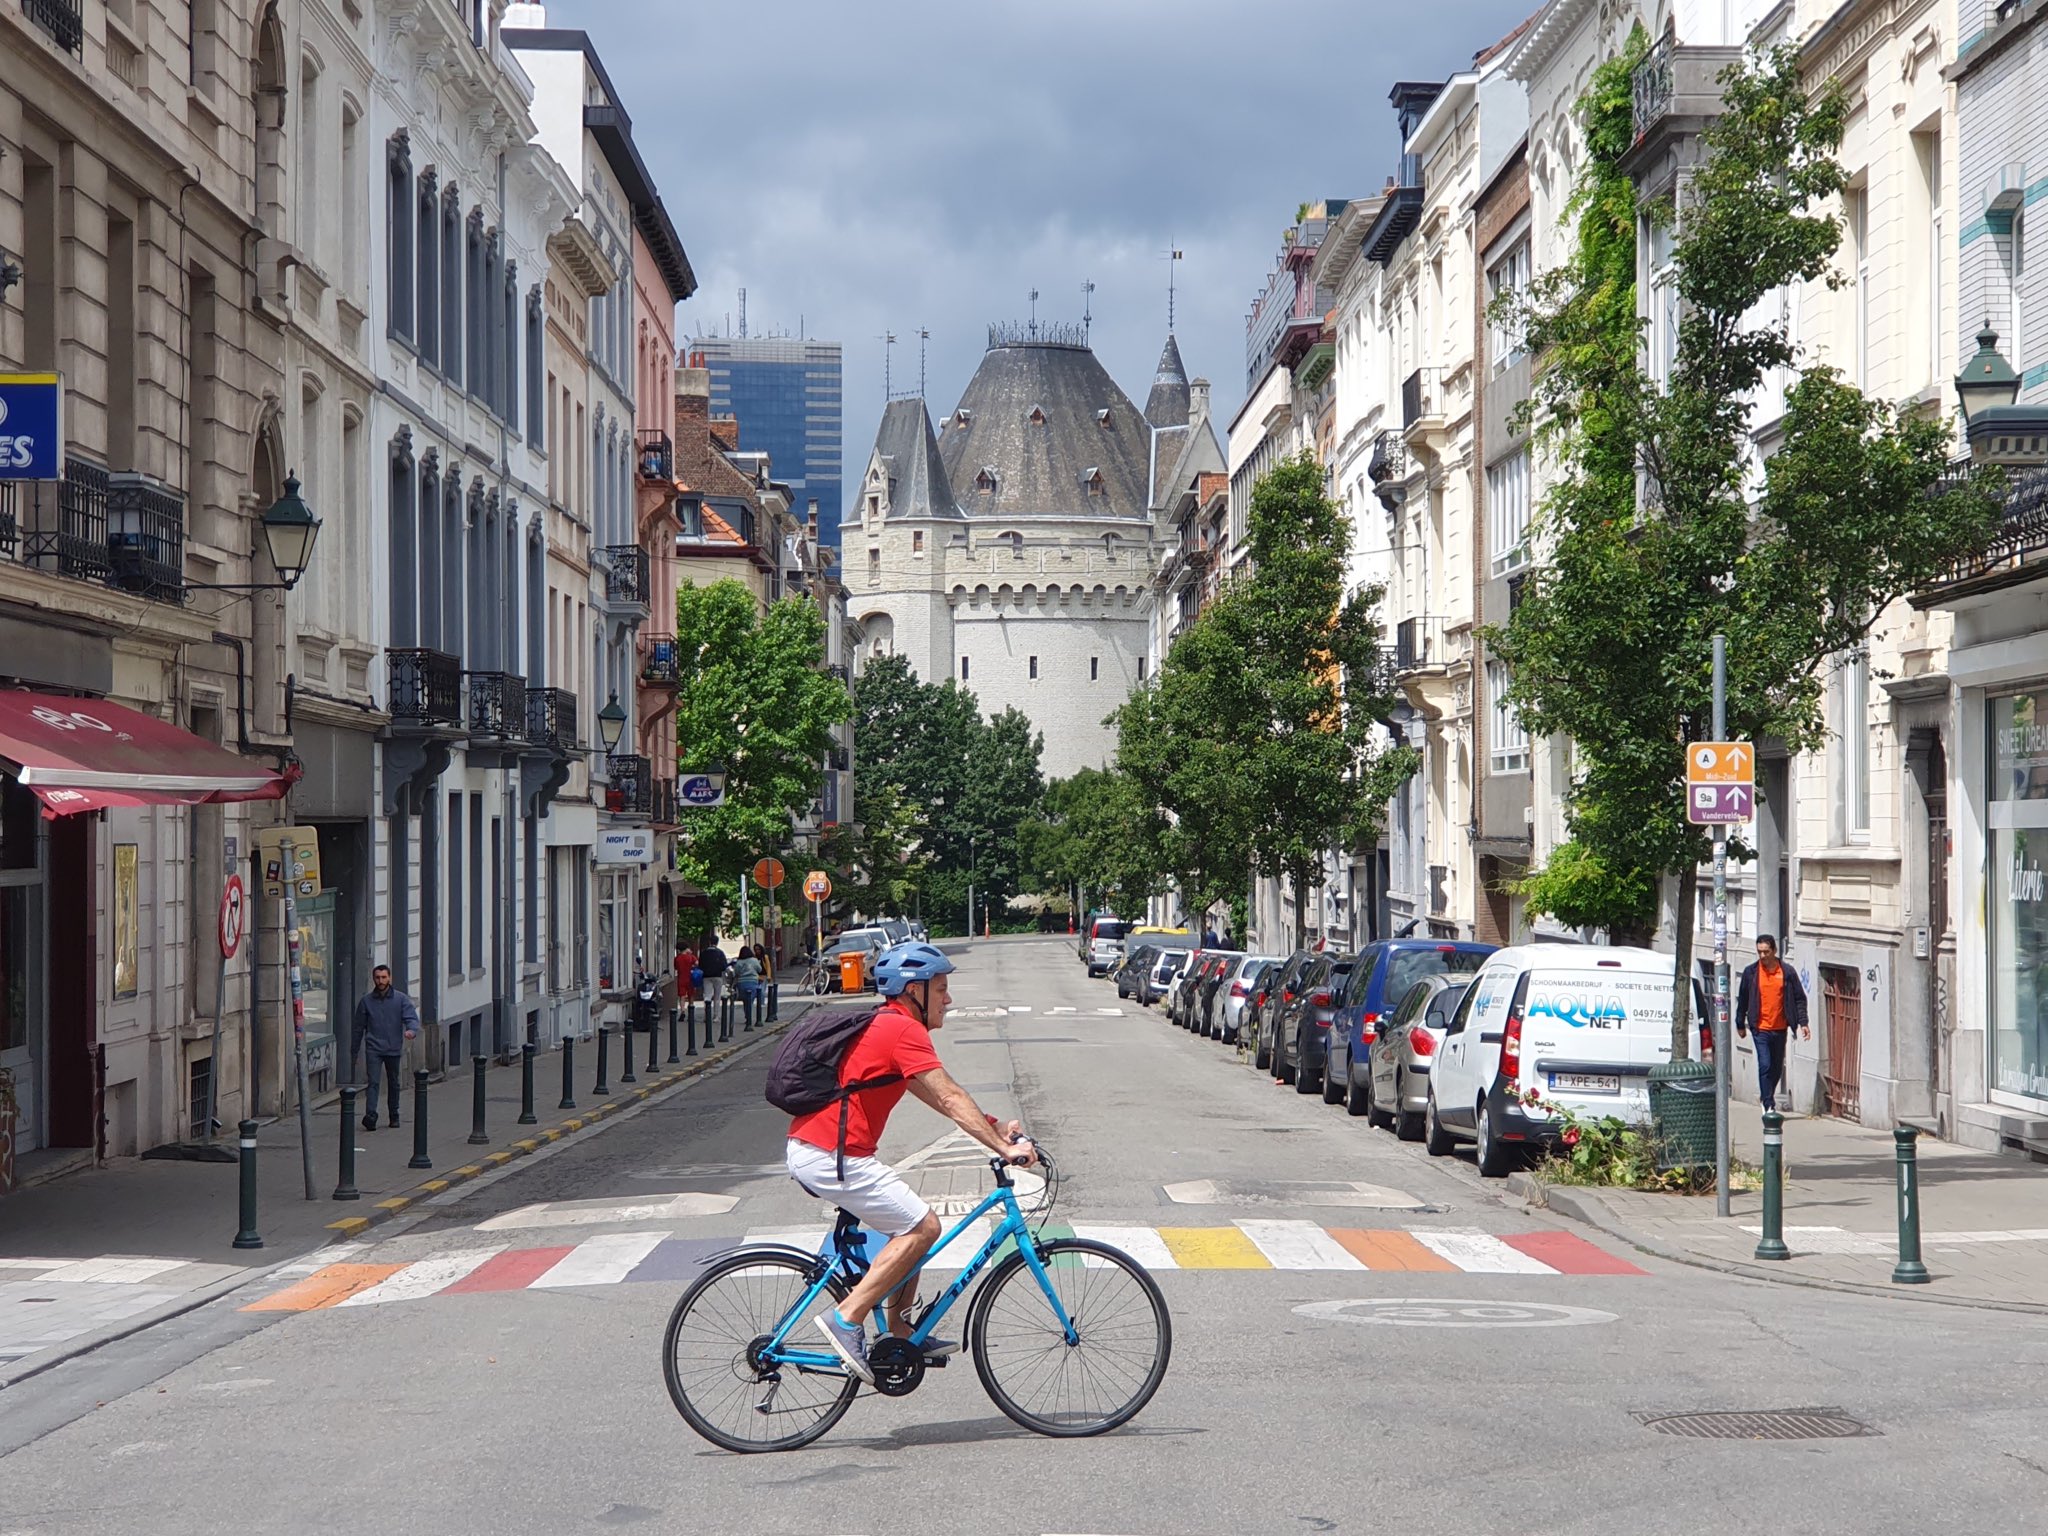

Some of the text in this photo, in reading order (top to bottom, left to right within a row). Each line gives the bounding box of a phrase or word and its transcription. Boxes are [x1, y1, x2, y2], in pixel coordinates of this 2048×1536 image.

[1999, 724, 2048, 755] SWEET DREA
[1700, 793, 1712, 802] 9a
[606, 836, 630, 845] NIGHT
[623, 849, 644, 858] SHOP
[2006, 849, 2045, 902] Literie
[1530, 979, 1603, 988] SCHOONMAAKBEDRIJF
[1615, 982, 1642, 991] SOCIETE
[1527, 992, 1628, 1028] AQUA
[1632, 1008, 1668, 1018] 0497/54
[1589, 1015, 1628, 1030] NET
[946, 1239, 998, 1298] TREK
